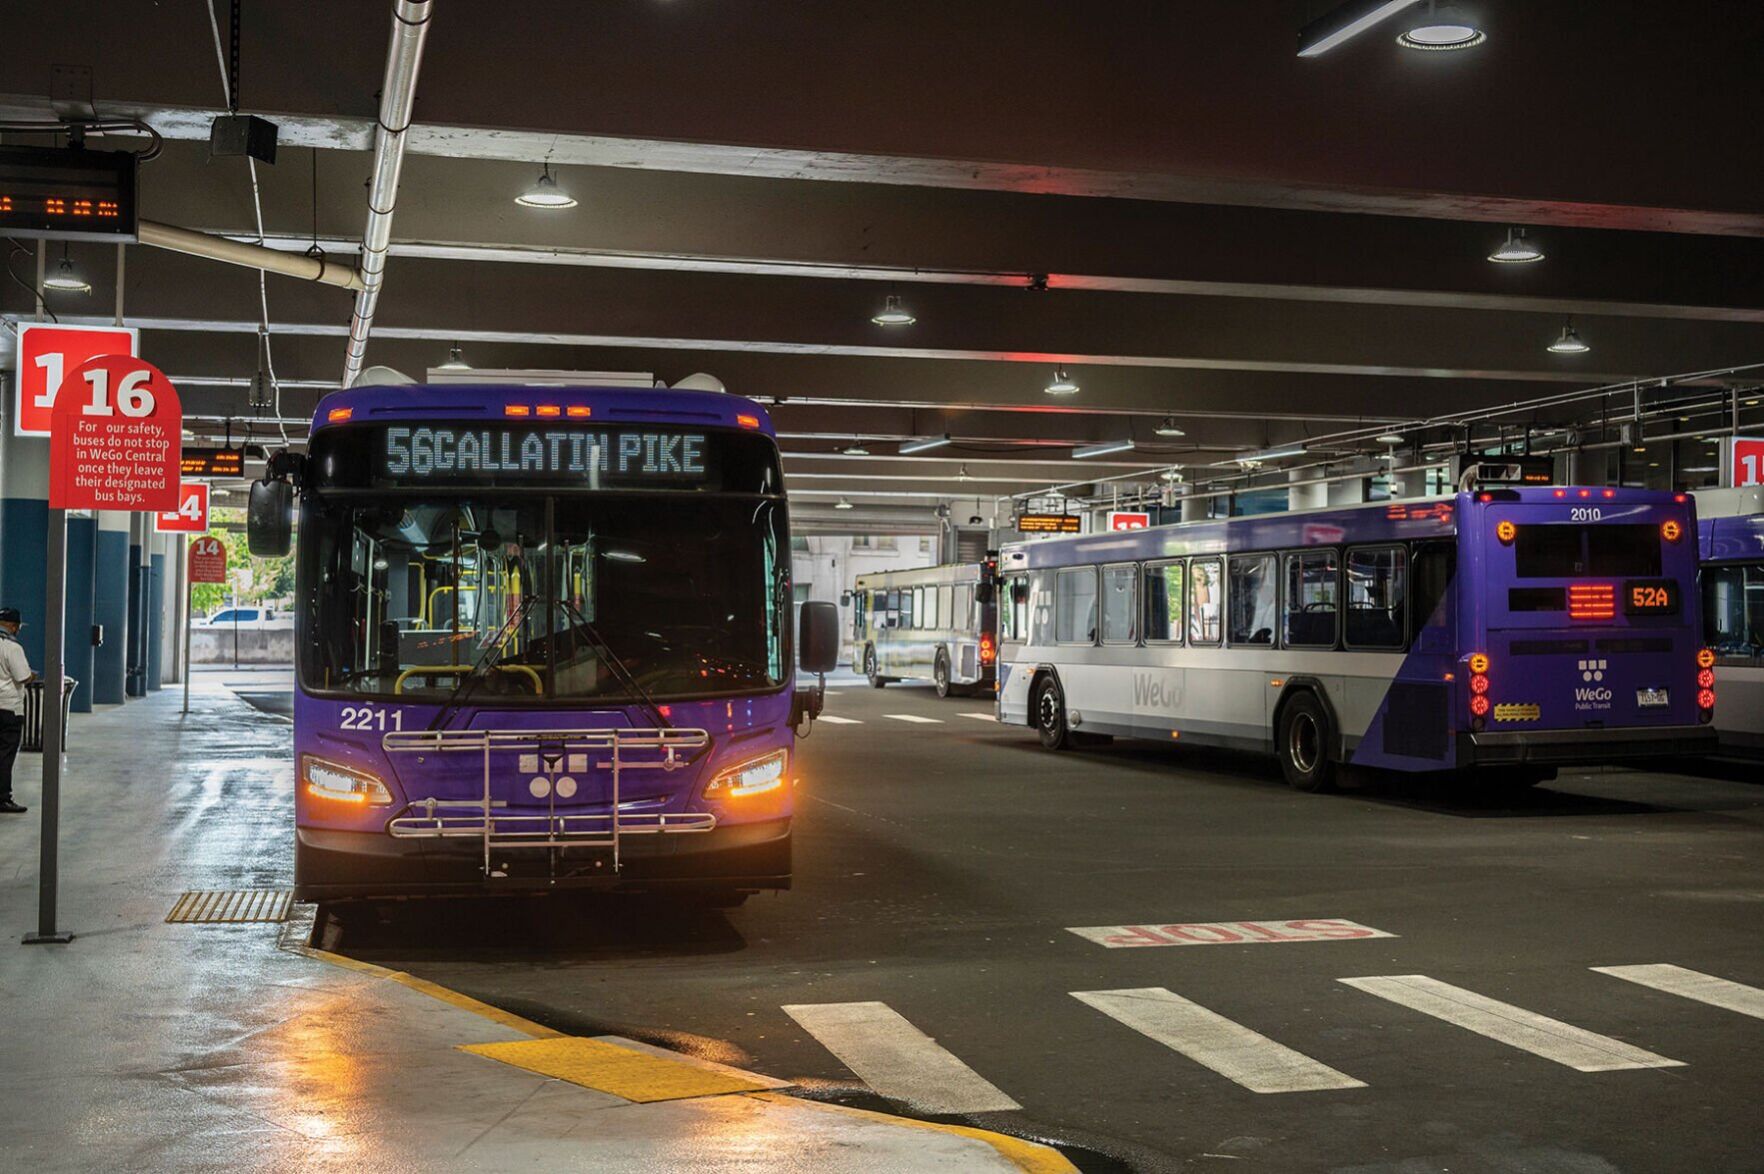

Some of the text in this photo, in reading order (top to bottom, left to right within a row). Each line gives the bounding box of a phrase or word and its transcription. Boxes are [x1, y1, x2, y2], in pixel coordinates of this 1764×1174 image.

[82, 368, 155, 418] 16
[79, 420, 98, 432] For
[128, 422, 165, 438] safety,
[73, 433, 169, 449] buses do not stop
[76, 447, 166, 462] in WeGo Central
[387, 427, 705, 473] 56 GALLATIN PIKE
[78, 462, 164, 479] once they leave
[1741, 455, 1764, 487] 1
[75, 475, 165, 491] their designated
[95, 489, 145, 506] bus bays.
[1571, 508, 1601, 521] 2010
[197, 540, 219, 556] 14
[1633, 587, 1668, 607] 52A
[1575, 687, 1612, 701] WeGo
[1575, 702, 1592, 710] Public
[340, 707, 402, 731] 2211
[1103, 919, 1375, 946] STOP
